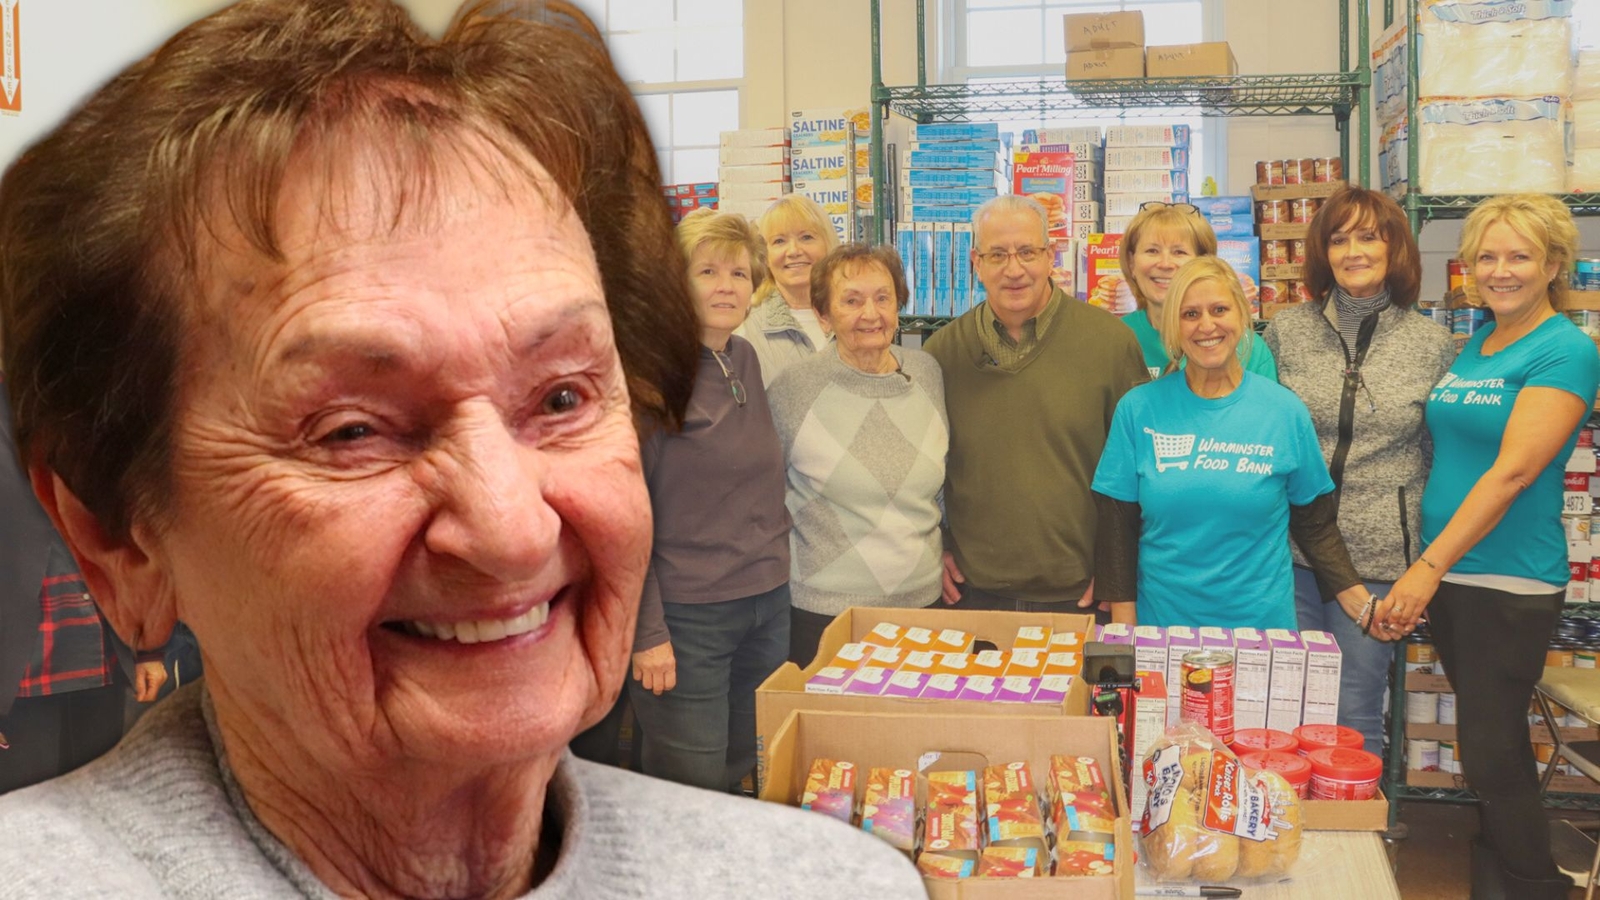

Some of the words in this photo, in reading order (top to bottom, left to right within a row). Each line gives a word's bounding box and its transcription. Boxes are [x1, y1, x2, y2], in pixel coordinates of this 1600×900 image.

[792, 119, 845, 133] SALTINE
[792, 156, 845, 170] SALTINE
[1016, 163, 1040, 174] Pearl
[1040, 164, 1072, 176] Milling
[806, 190, 848, 204] ALTINE
[1090, 245, 1114, 255] Pearl
[1566, 496, 1585, 511] 4873
[1223, 760, 1236, 792] Kaiser
[1219, 792, 1234, 822] Rolls
[1247, 795, 1259, 837] BAKERY
